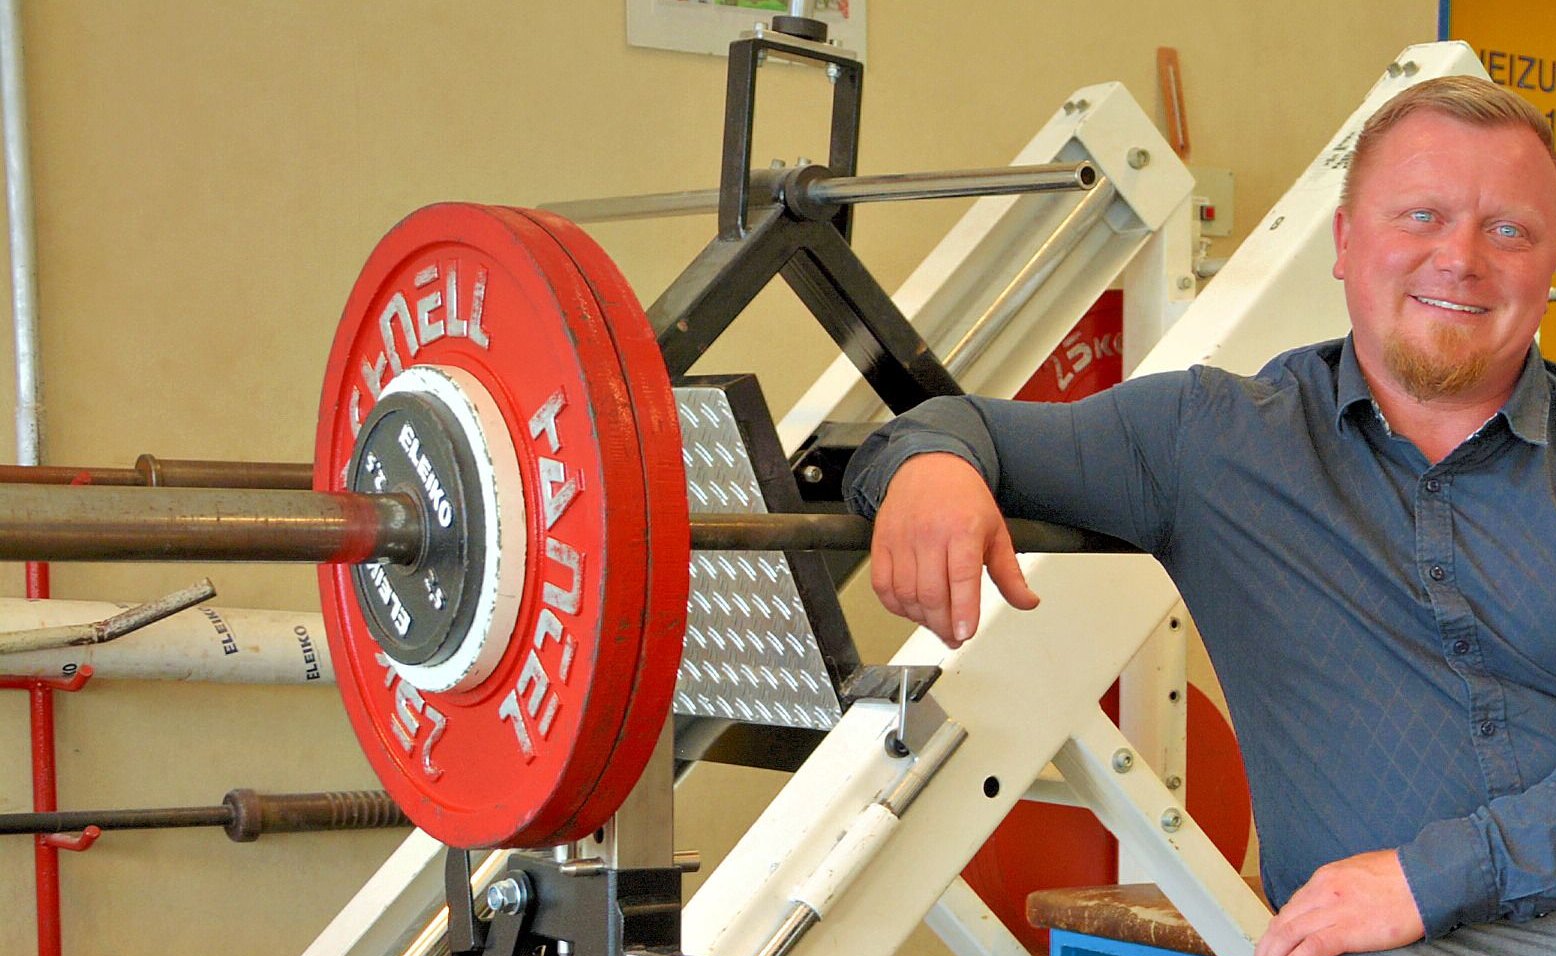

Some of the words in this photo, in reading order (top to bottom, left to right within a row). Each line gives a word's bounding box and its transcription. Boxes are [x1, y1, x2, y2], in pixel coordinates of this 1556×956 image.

[398, 422, 454, 529] ELEIKO
[366, 560, 413, 637] ELEIK
[294, 624, 321, 681] ELEIKO
